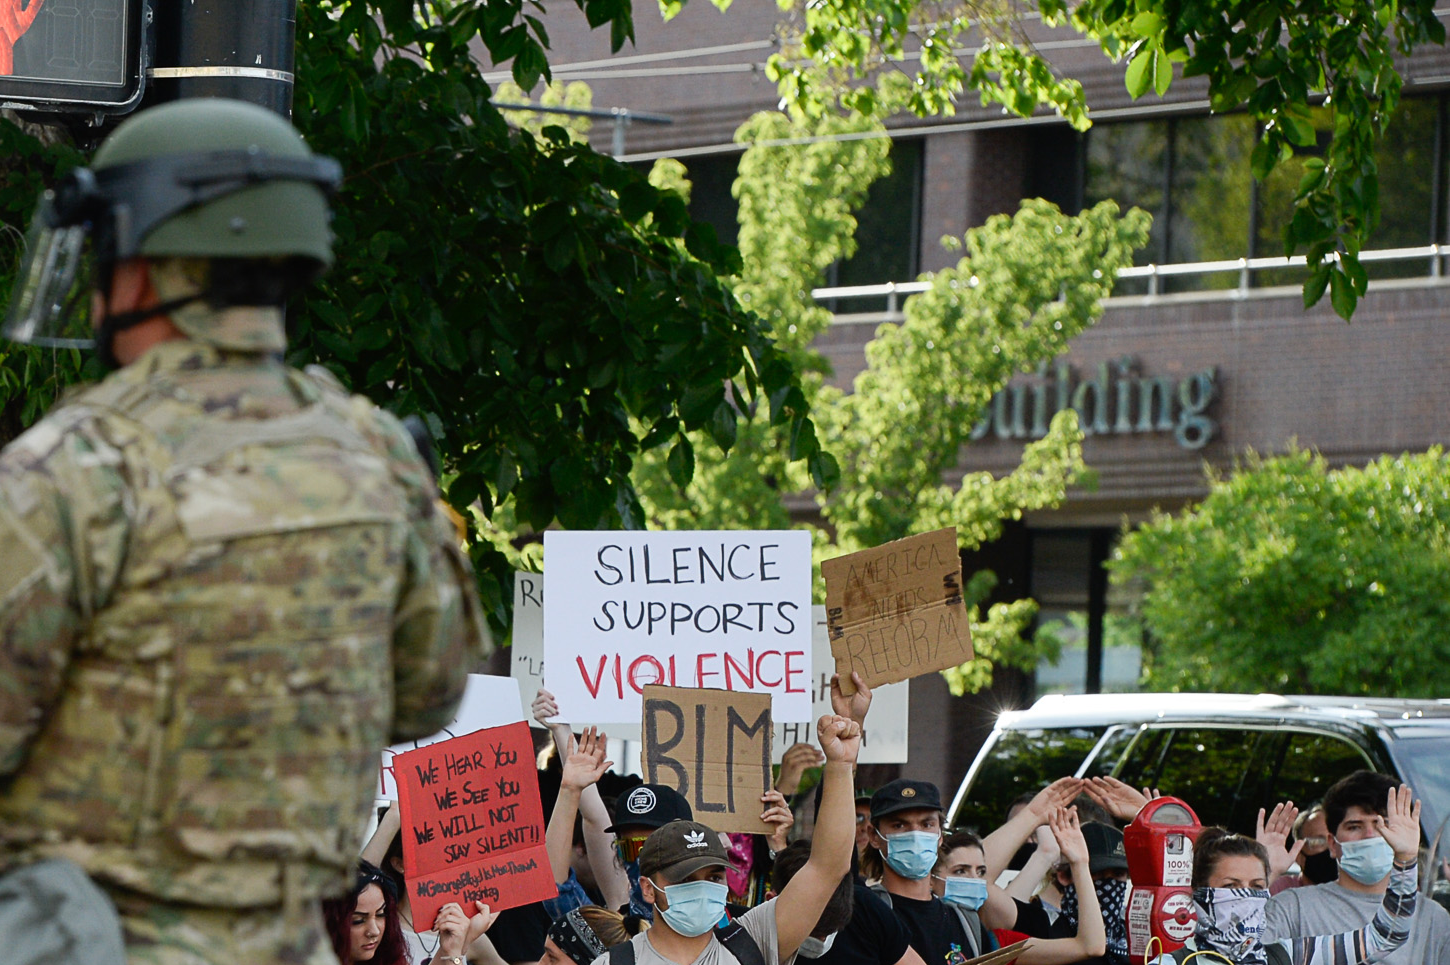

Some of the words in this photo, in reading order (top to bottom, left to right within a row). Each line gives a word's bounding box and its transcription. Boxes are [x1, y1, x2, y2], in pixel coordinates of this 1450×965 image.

[970, 354, 1218, 449] uilding
[593, 543, 781, 586] SILENCE
[845, 543, 943, 590] AMERICA
[593, 600, 799, 636] SUPPORTS
[845, 612, 965, 679] REFORM
[575, 647, 807, 700] VIOLENCE
[415, 758, 439, 789] WE
[444, 750, 487, 781] HEAR
[645, 698, 771, 814] BLM
[434, 786, 458, 812] WE
[462, 780, 490, 806] SEE
[413, 821, 436, 846] WE
[438, 813, 485, 839] WILL
[488, 803, 520, 827] NOT
[443, 842, 471, 864] STAY
[476, 825, 540, 855] SILENT!!
[686, 841, 708, 849] adidas
[1167, 860, 1190, 869] 100%
